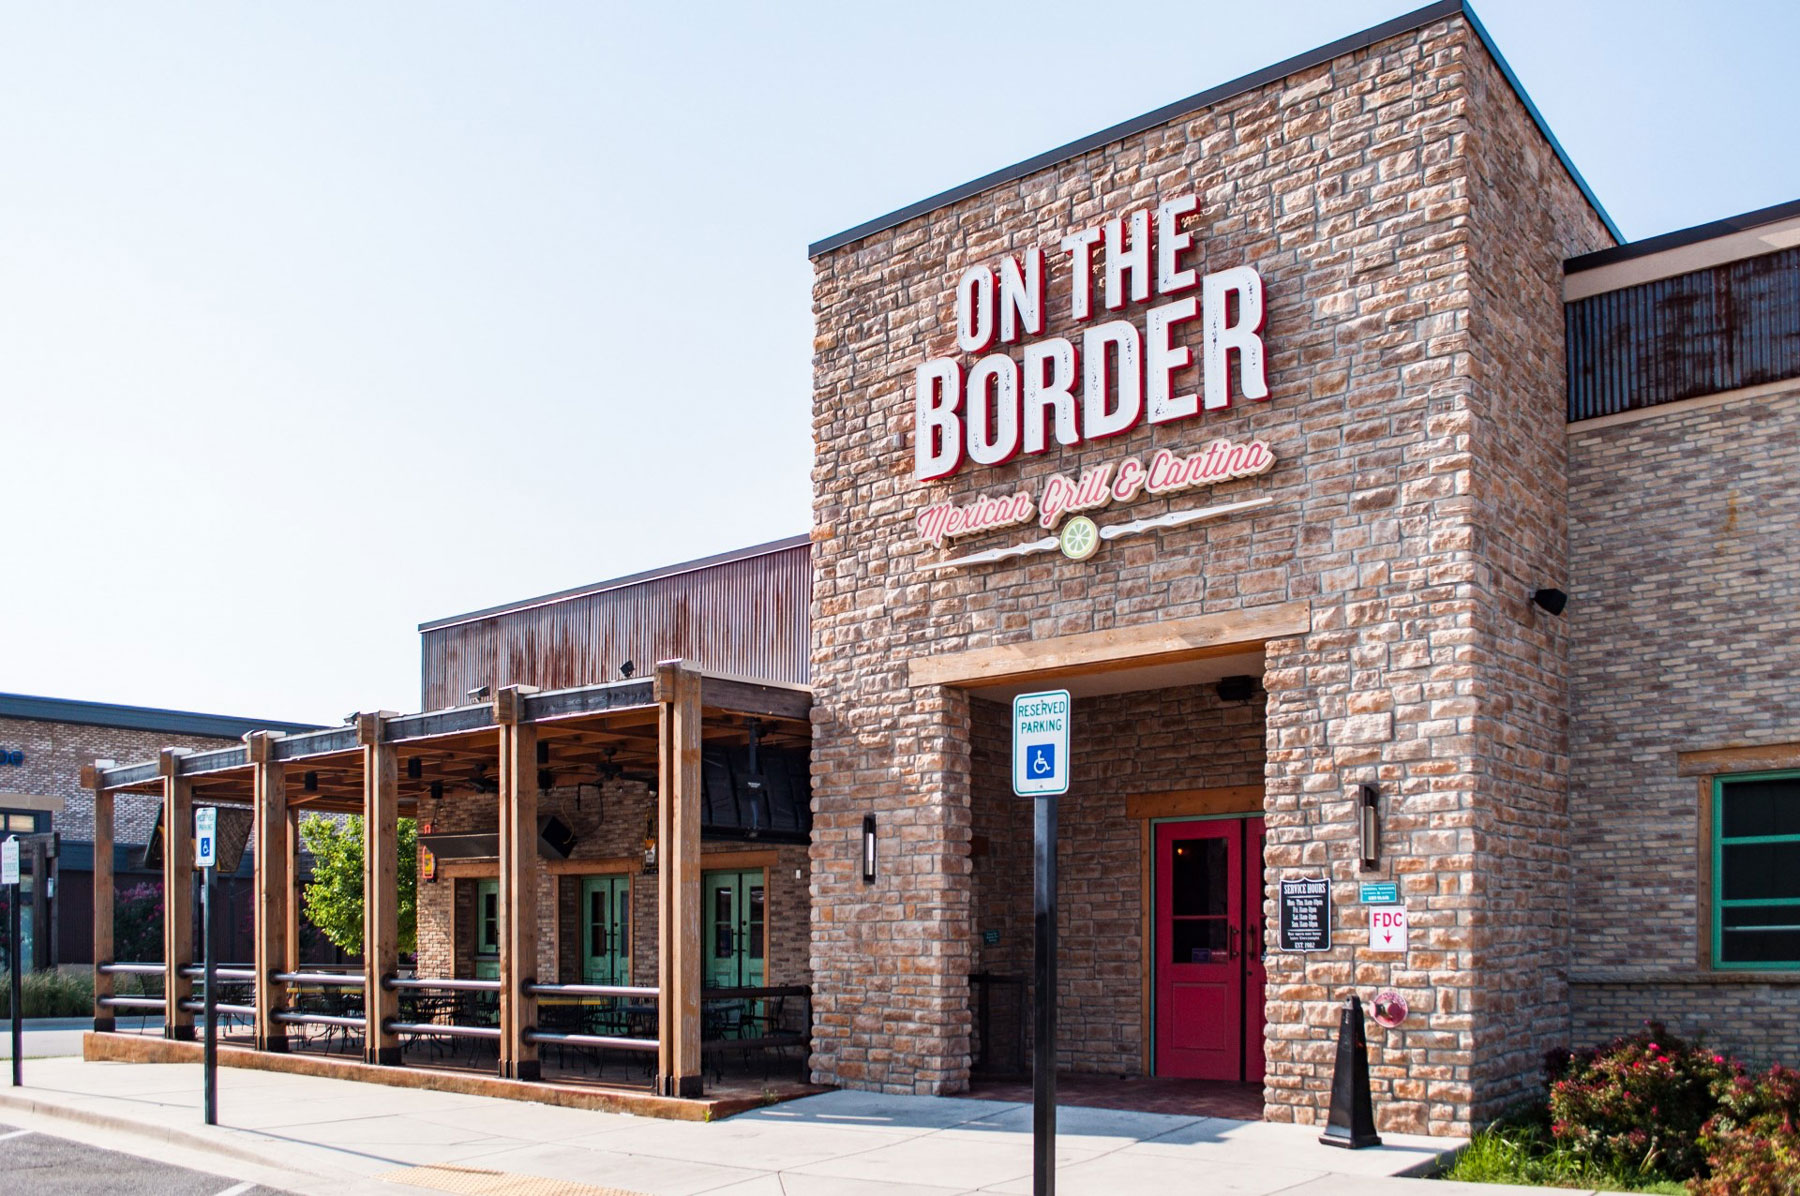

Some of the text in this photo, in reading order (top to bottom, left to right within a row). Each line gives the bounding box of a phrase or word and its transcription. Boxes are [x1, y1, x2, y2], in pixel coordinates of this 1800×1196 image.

[957, 194, 1199, 352] ON THE
[915, 266, 1269, 481] BORDER
[917, 443, 1269, 543] Mexican Grill & Cantina
[1019, 701, 1065, 717] RESERVED
[1021, 719, 1062, 734] PARKING
[1284, 883, 1326, 894] SERVICE HOURS
[1373, 912, 1403, 927] FDC
